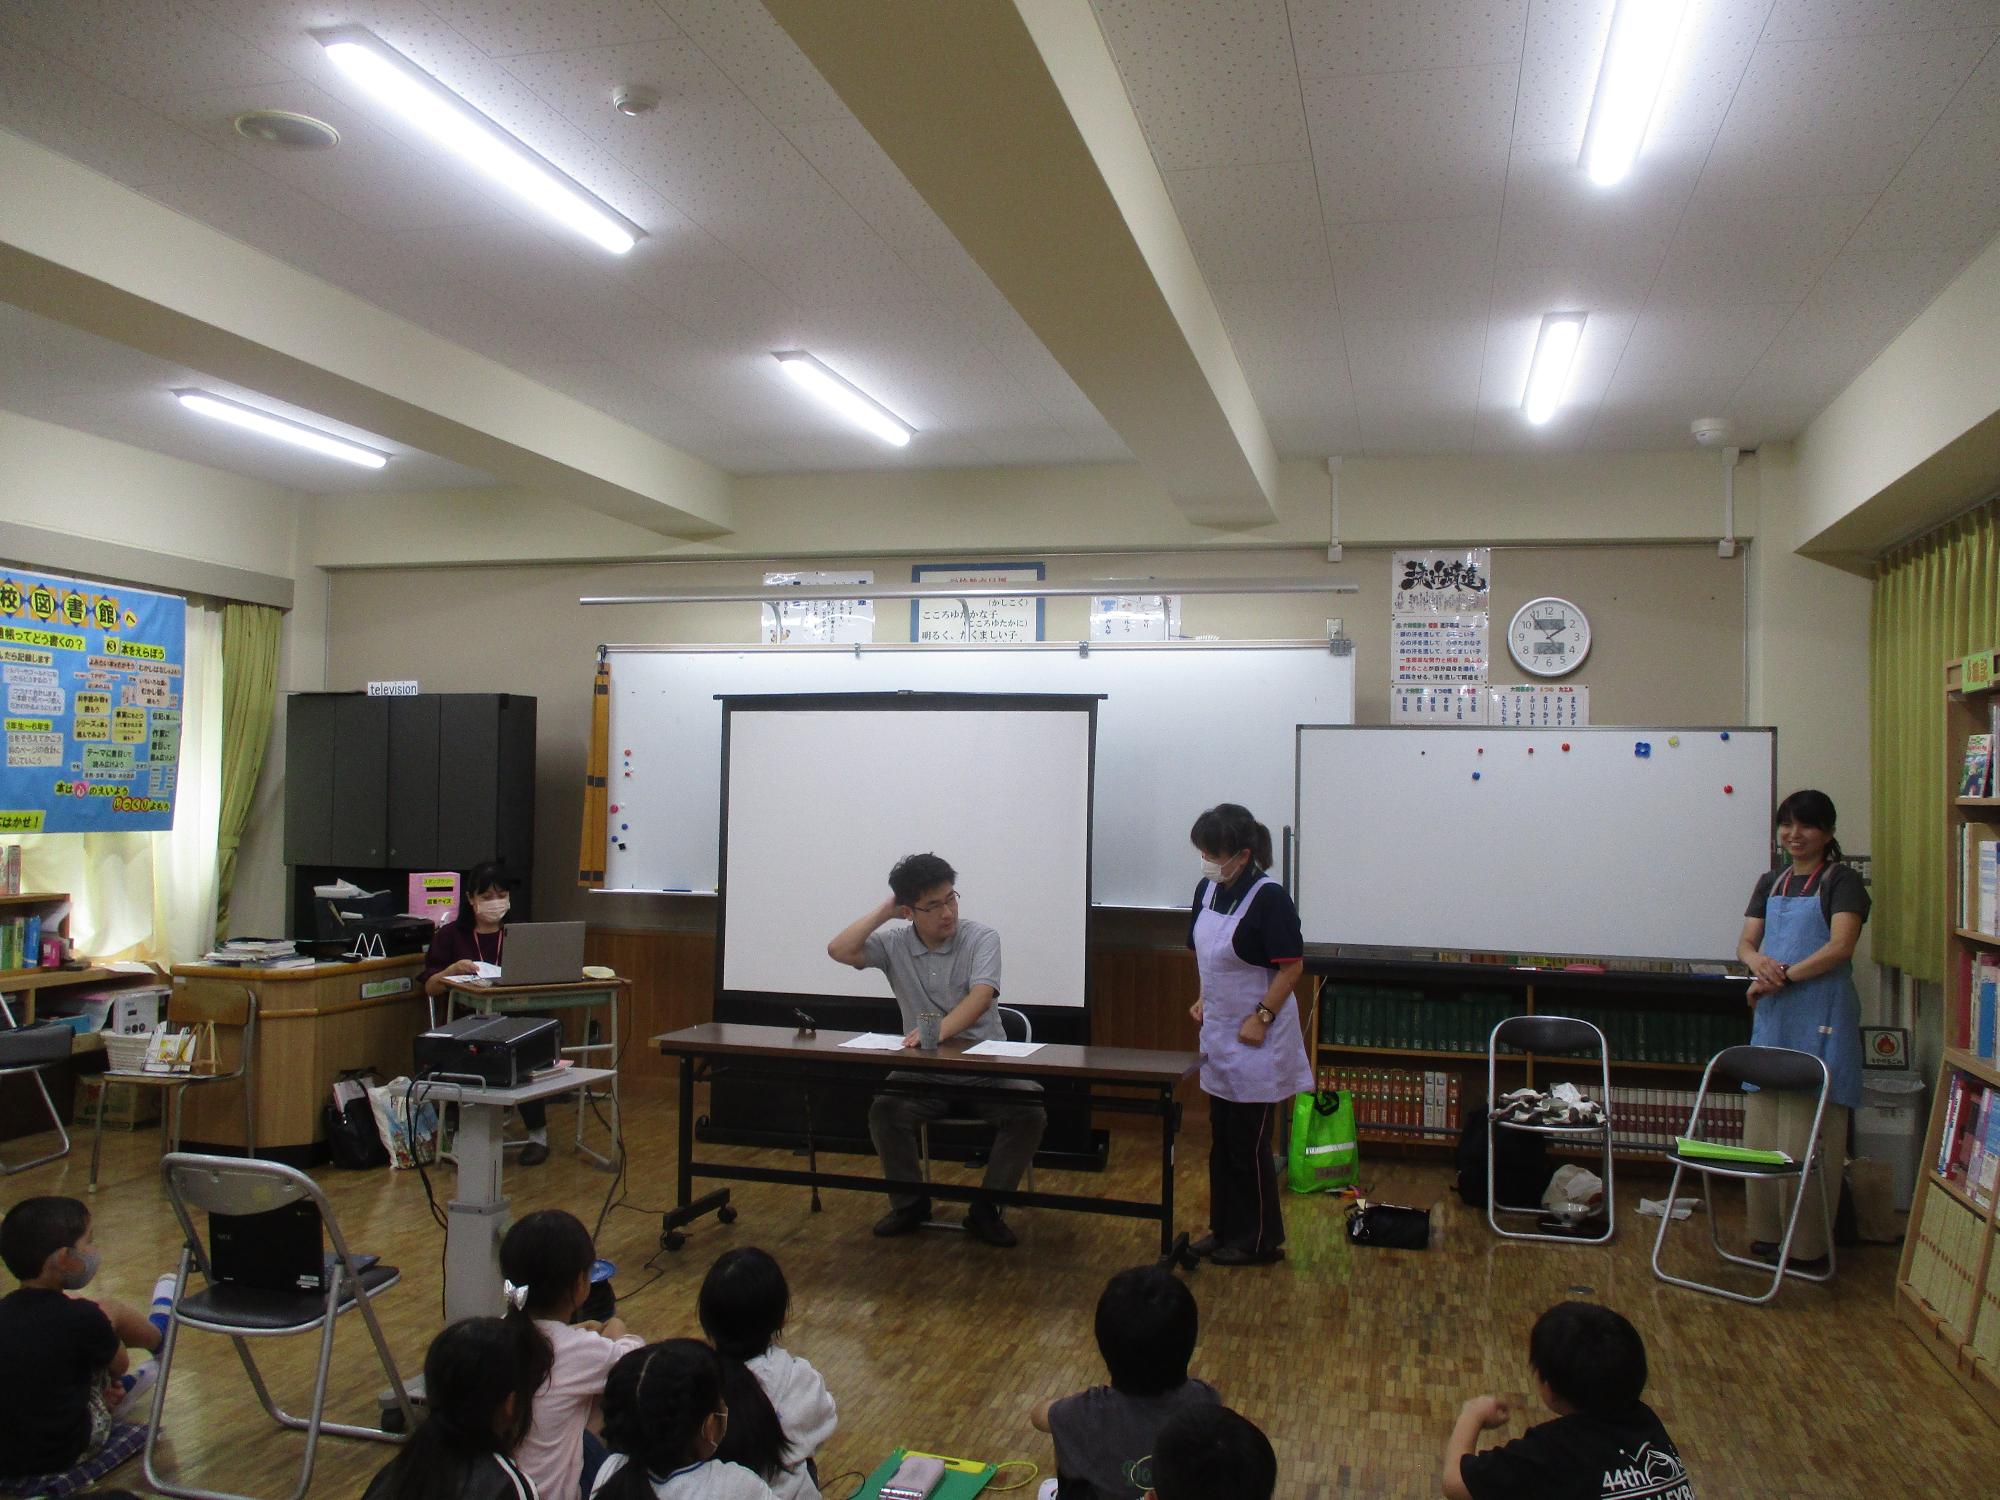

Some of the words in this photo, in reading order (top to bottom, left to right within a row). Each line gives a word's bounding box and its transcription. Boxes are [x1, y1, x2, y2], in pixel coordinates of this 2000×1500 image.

[1545, 607, 1554, 615] 12
[1570, 620, 1576, 628] 2
[1574, 633, 1580, 641] 3
[1522, 646, 1529, 654] 8
[1546, 658, 1552, 667] 6
[371, 682, 417, 696] television
[1602, 1464, 1647, 1491] 44th
